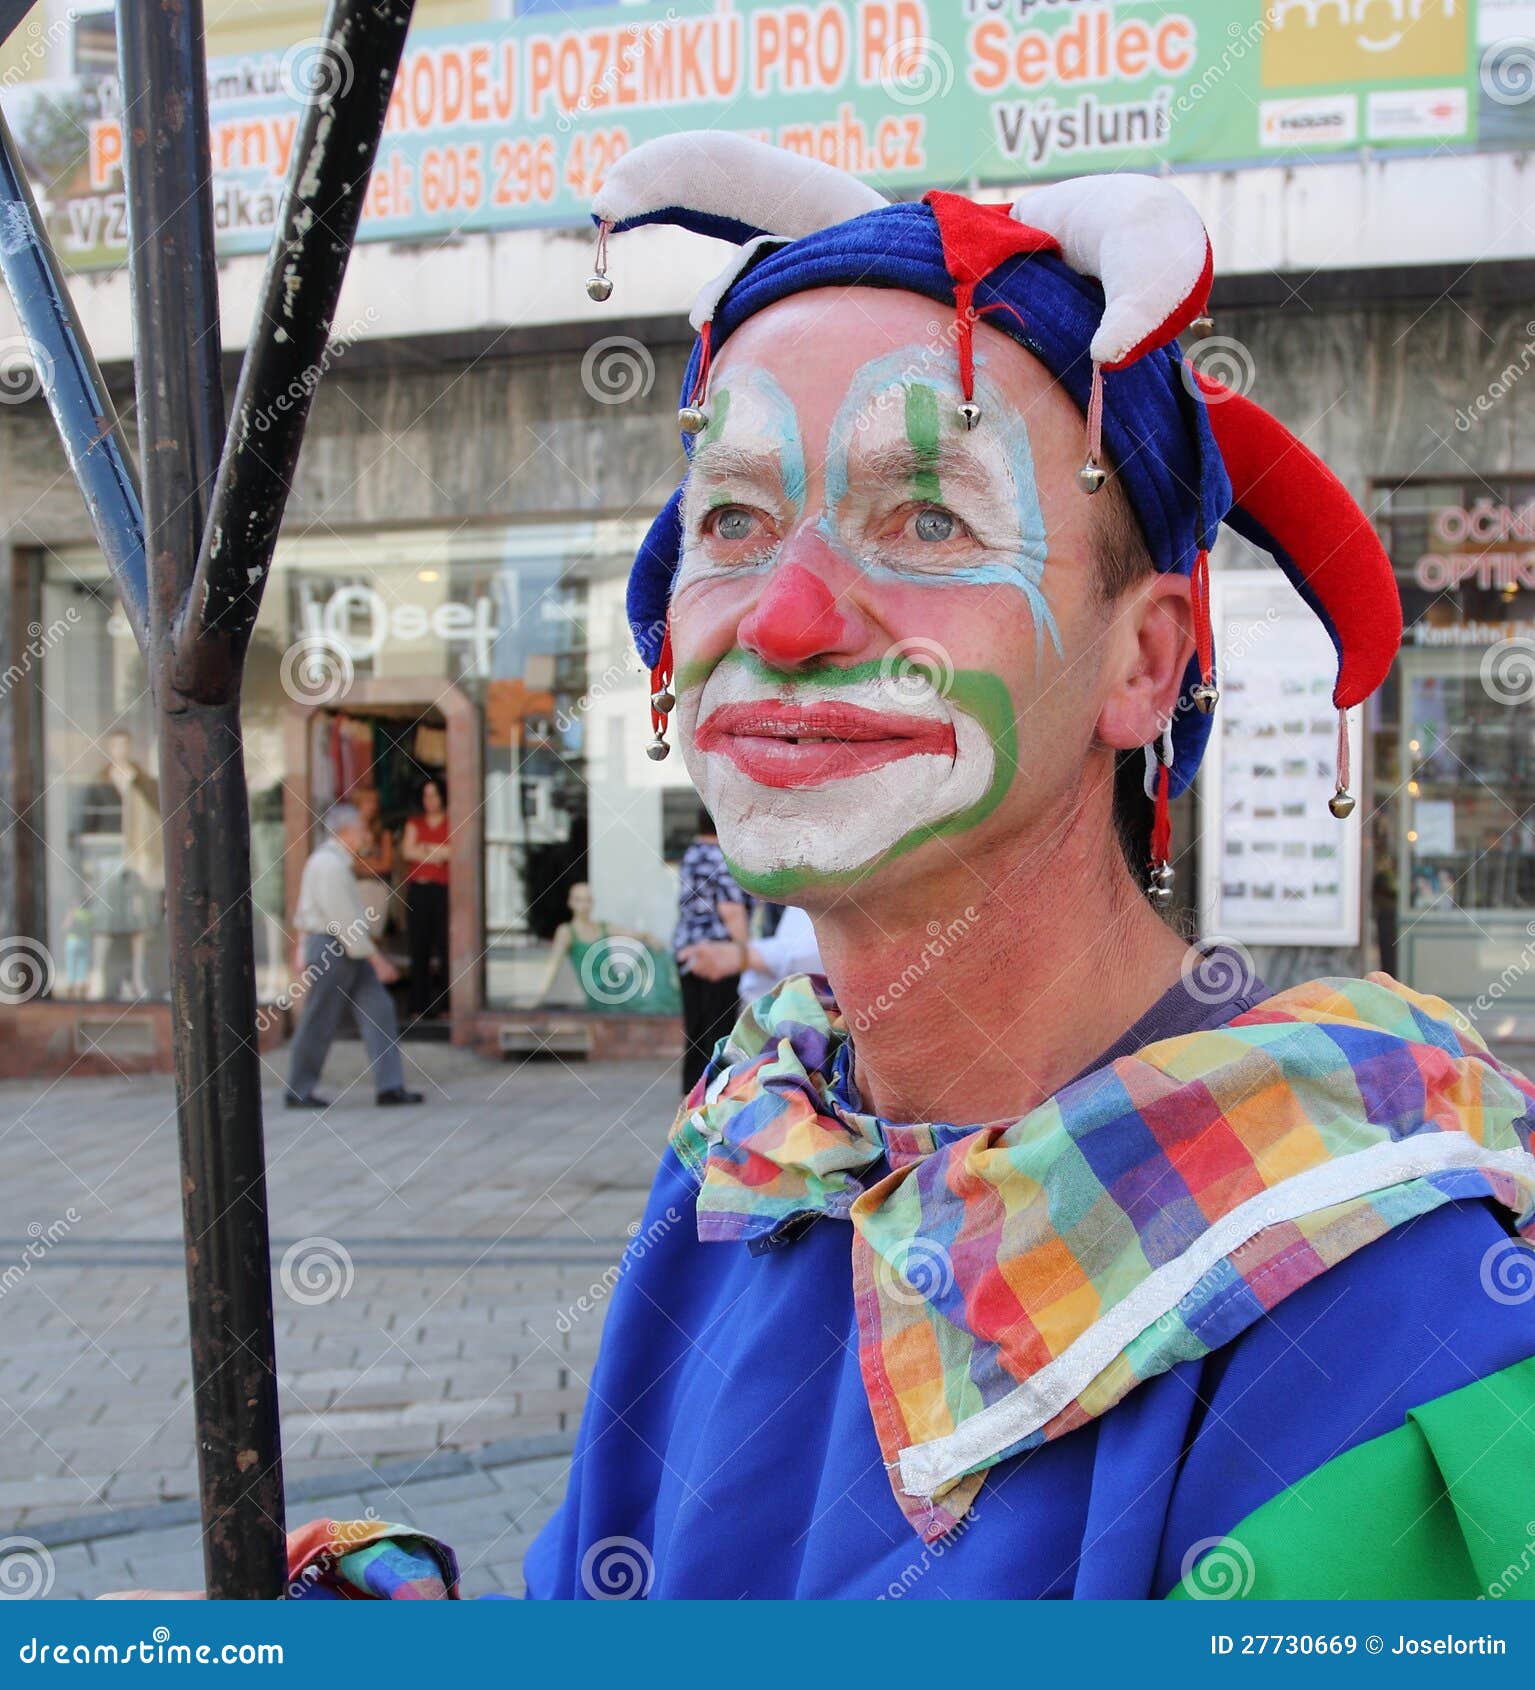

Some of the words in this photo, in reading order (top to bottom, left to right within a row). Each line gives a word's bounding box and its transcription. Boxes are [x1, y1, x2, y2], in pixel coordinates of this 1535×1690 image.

[385, 44, 516, 131] RODEJ
[755, 5, 845, 92] PRO
[862, 1, 924, 82] RD
[972, 10, 1191, 89] Sedlec
[999, 91, 1164, 162] Výsluní
[364, 151, 411, 218] el:
[422, 145, 482, 213] 605
[493, 136, 556, 205] 296
[1436, 499, 1535, 543] OČN
[1417, 553, 1535, 592] OPTIK
